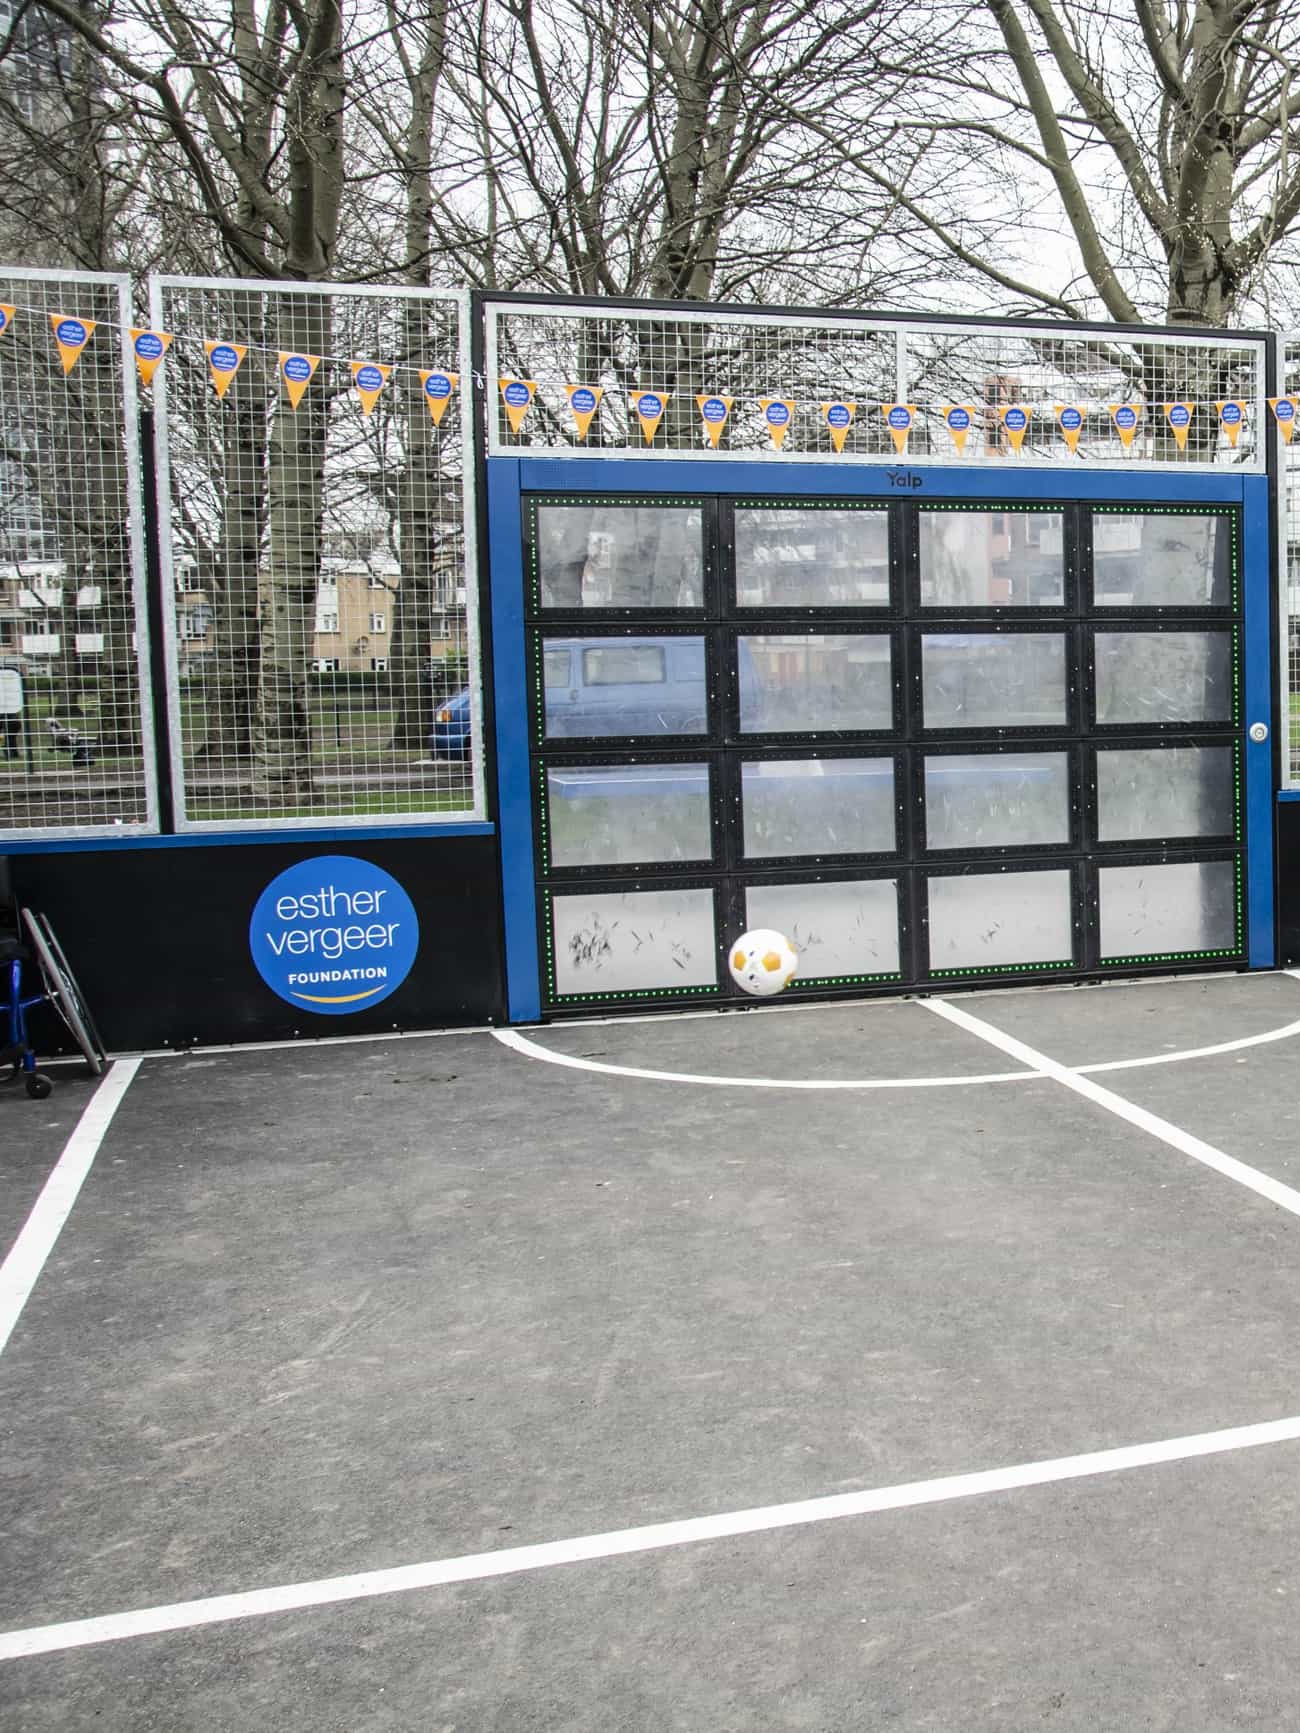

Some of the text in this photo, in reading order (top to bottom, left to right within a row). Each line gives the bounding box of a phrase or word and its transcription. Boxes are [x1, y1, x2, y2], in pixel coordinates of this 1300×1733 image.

[886, 471, 923, 489] Yalp
[276, 885, 388, 921] esther
[266, 923, 400, 959] vergeer
[288, 966, 388, 985] FOUNDATION
